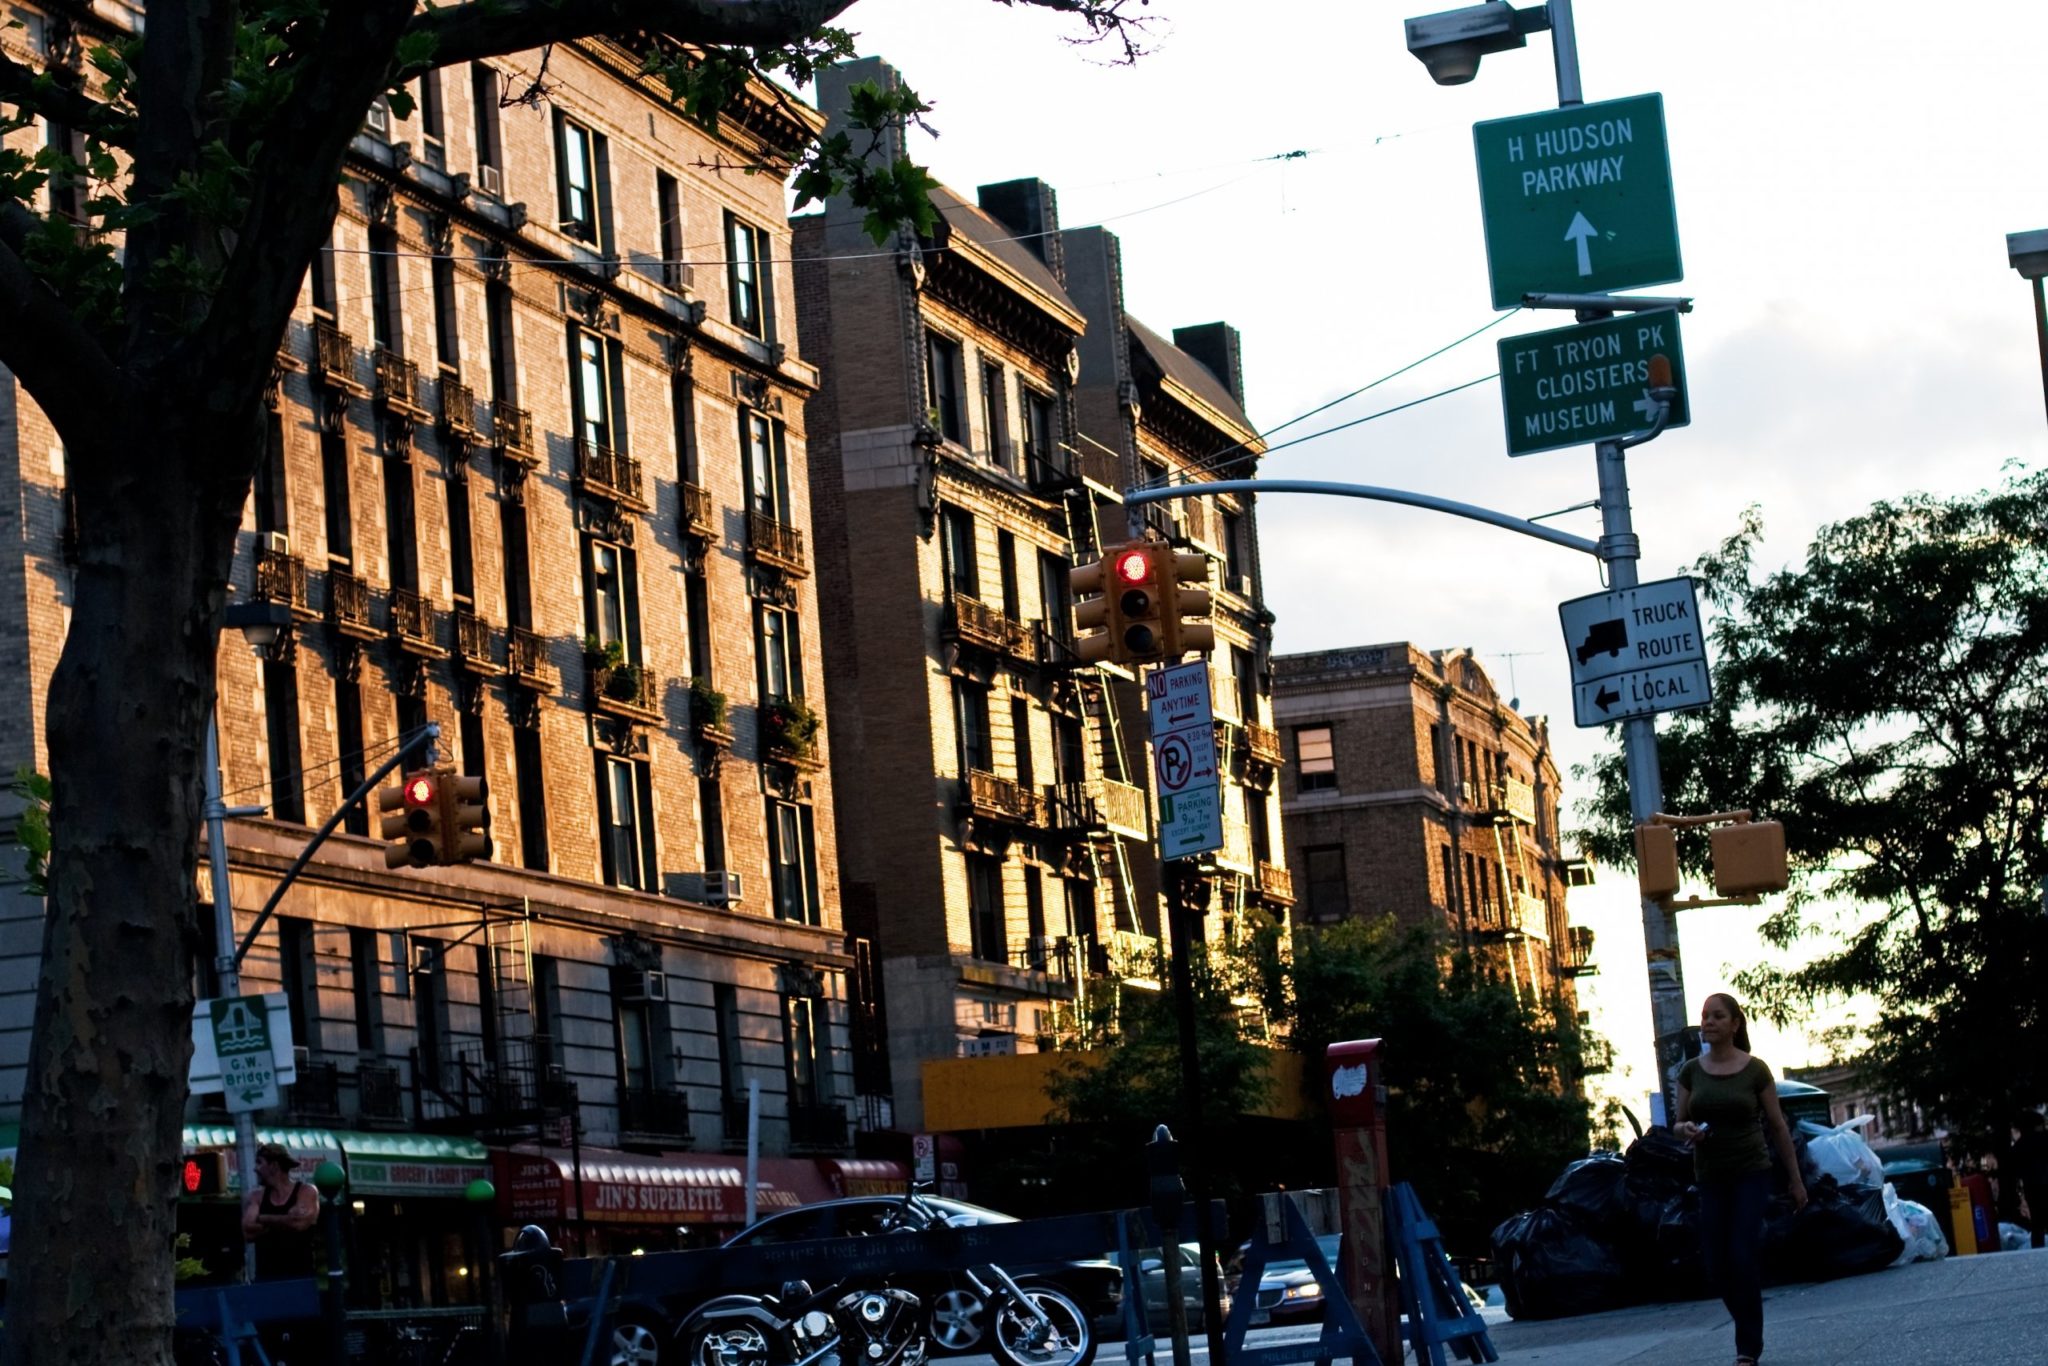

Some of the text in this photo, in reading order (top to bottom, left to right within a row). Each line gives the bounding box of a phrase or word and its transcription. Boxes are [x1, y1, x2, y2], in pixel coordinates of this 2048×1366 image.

[1508, 118, 1632, 162] H HUDSON
[1523, 155, 1624, 196] PARKWAY
[1515, 325, 1665, 374] FT TRYON PK
[1536, 360, 1649, 400] CLOISTERS
[1525, 401, 1615, 437] MUSEUM
[1632, 601, 1688, 626] TRUCK
[1637, 633, 1694, 659] ROUTE
[1150, 672, 1202, 698] NO PARKING
[1632, 676, 1690, 702] LOCAL
[1161, 693, 1200, 714] ANYTIME
[1178, 797, 1211, 813] PARKING
[225, 1070, 271, 1086] Bridge
[520, 1163, 550, 1176] JIN'S
[595, 1184, 636, 1210] JIN'S
[639, 1187, 724, 1211] SUPERETTE
